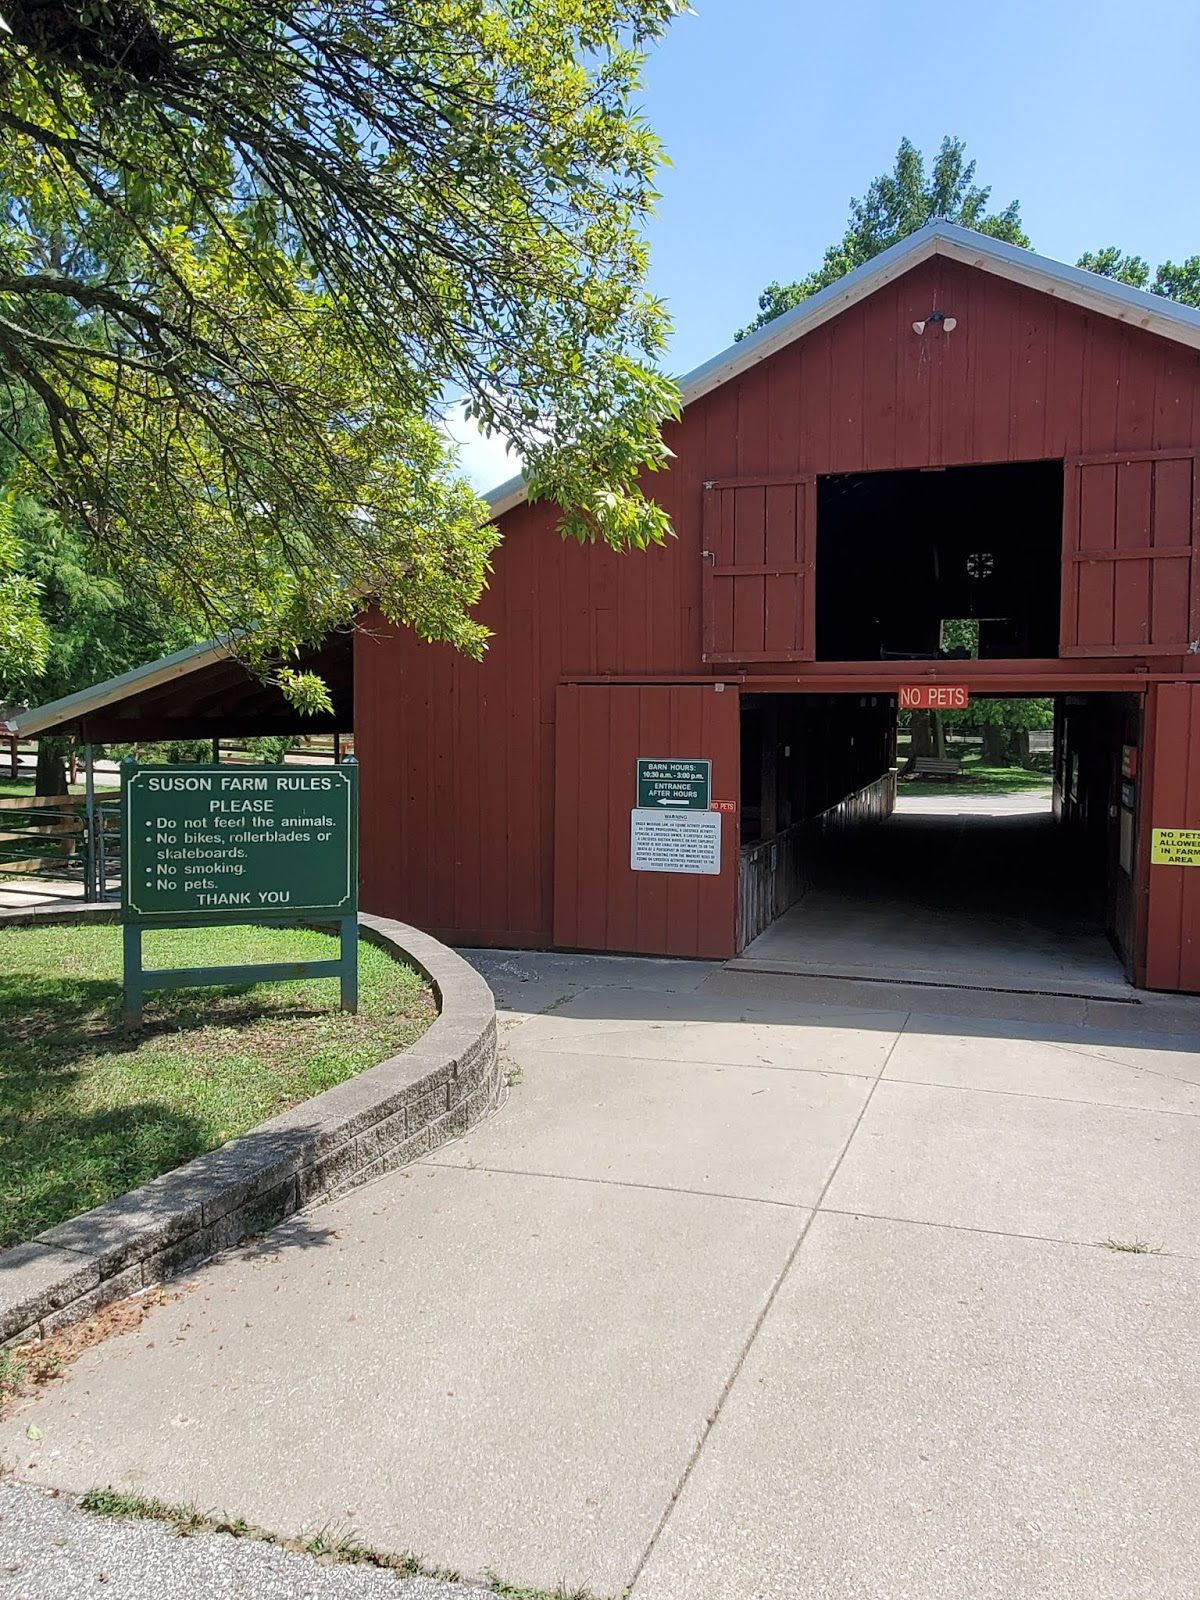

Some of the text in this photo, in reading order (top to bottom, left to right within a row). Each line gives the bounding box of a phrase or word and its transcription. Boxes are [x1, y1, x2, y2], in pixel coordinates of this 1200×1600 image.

[900, 688, 964, 705] NO PETS
[148, 778, 212, 791] SUSON
[221, 778, 267, 790] FARM
[277, 778, 331, 790] RULES
[210, 800, 274, 812] PLEASE
[157, 816, 336, 829] Do not feed the animals.
[157, 831, 331, 845] No bikes, rollerblades or
[157, 848, 248, 859] skateboards.
[157, 864, 246, 875] No smoking.
[157, 879, 218, 892] No pets.
[197, 891, 290, 906] THANK YOU
